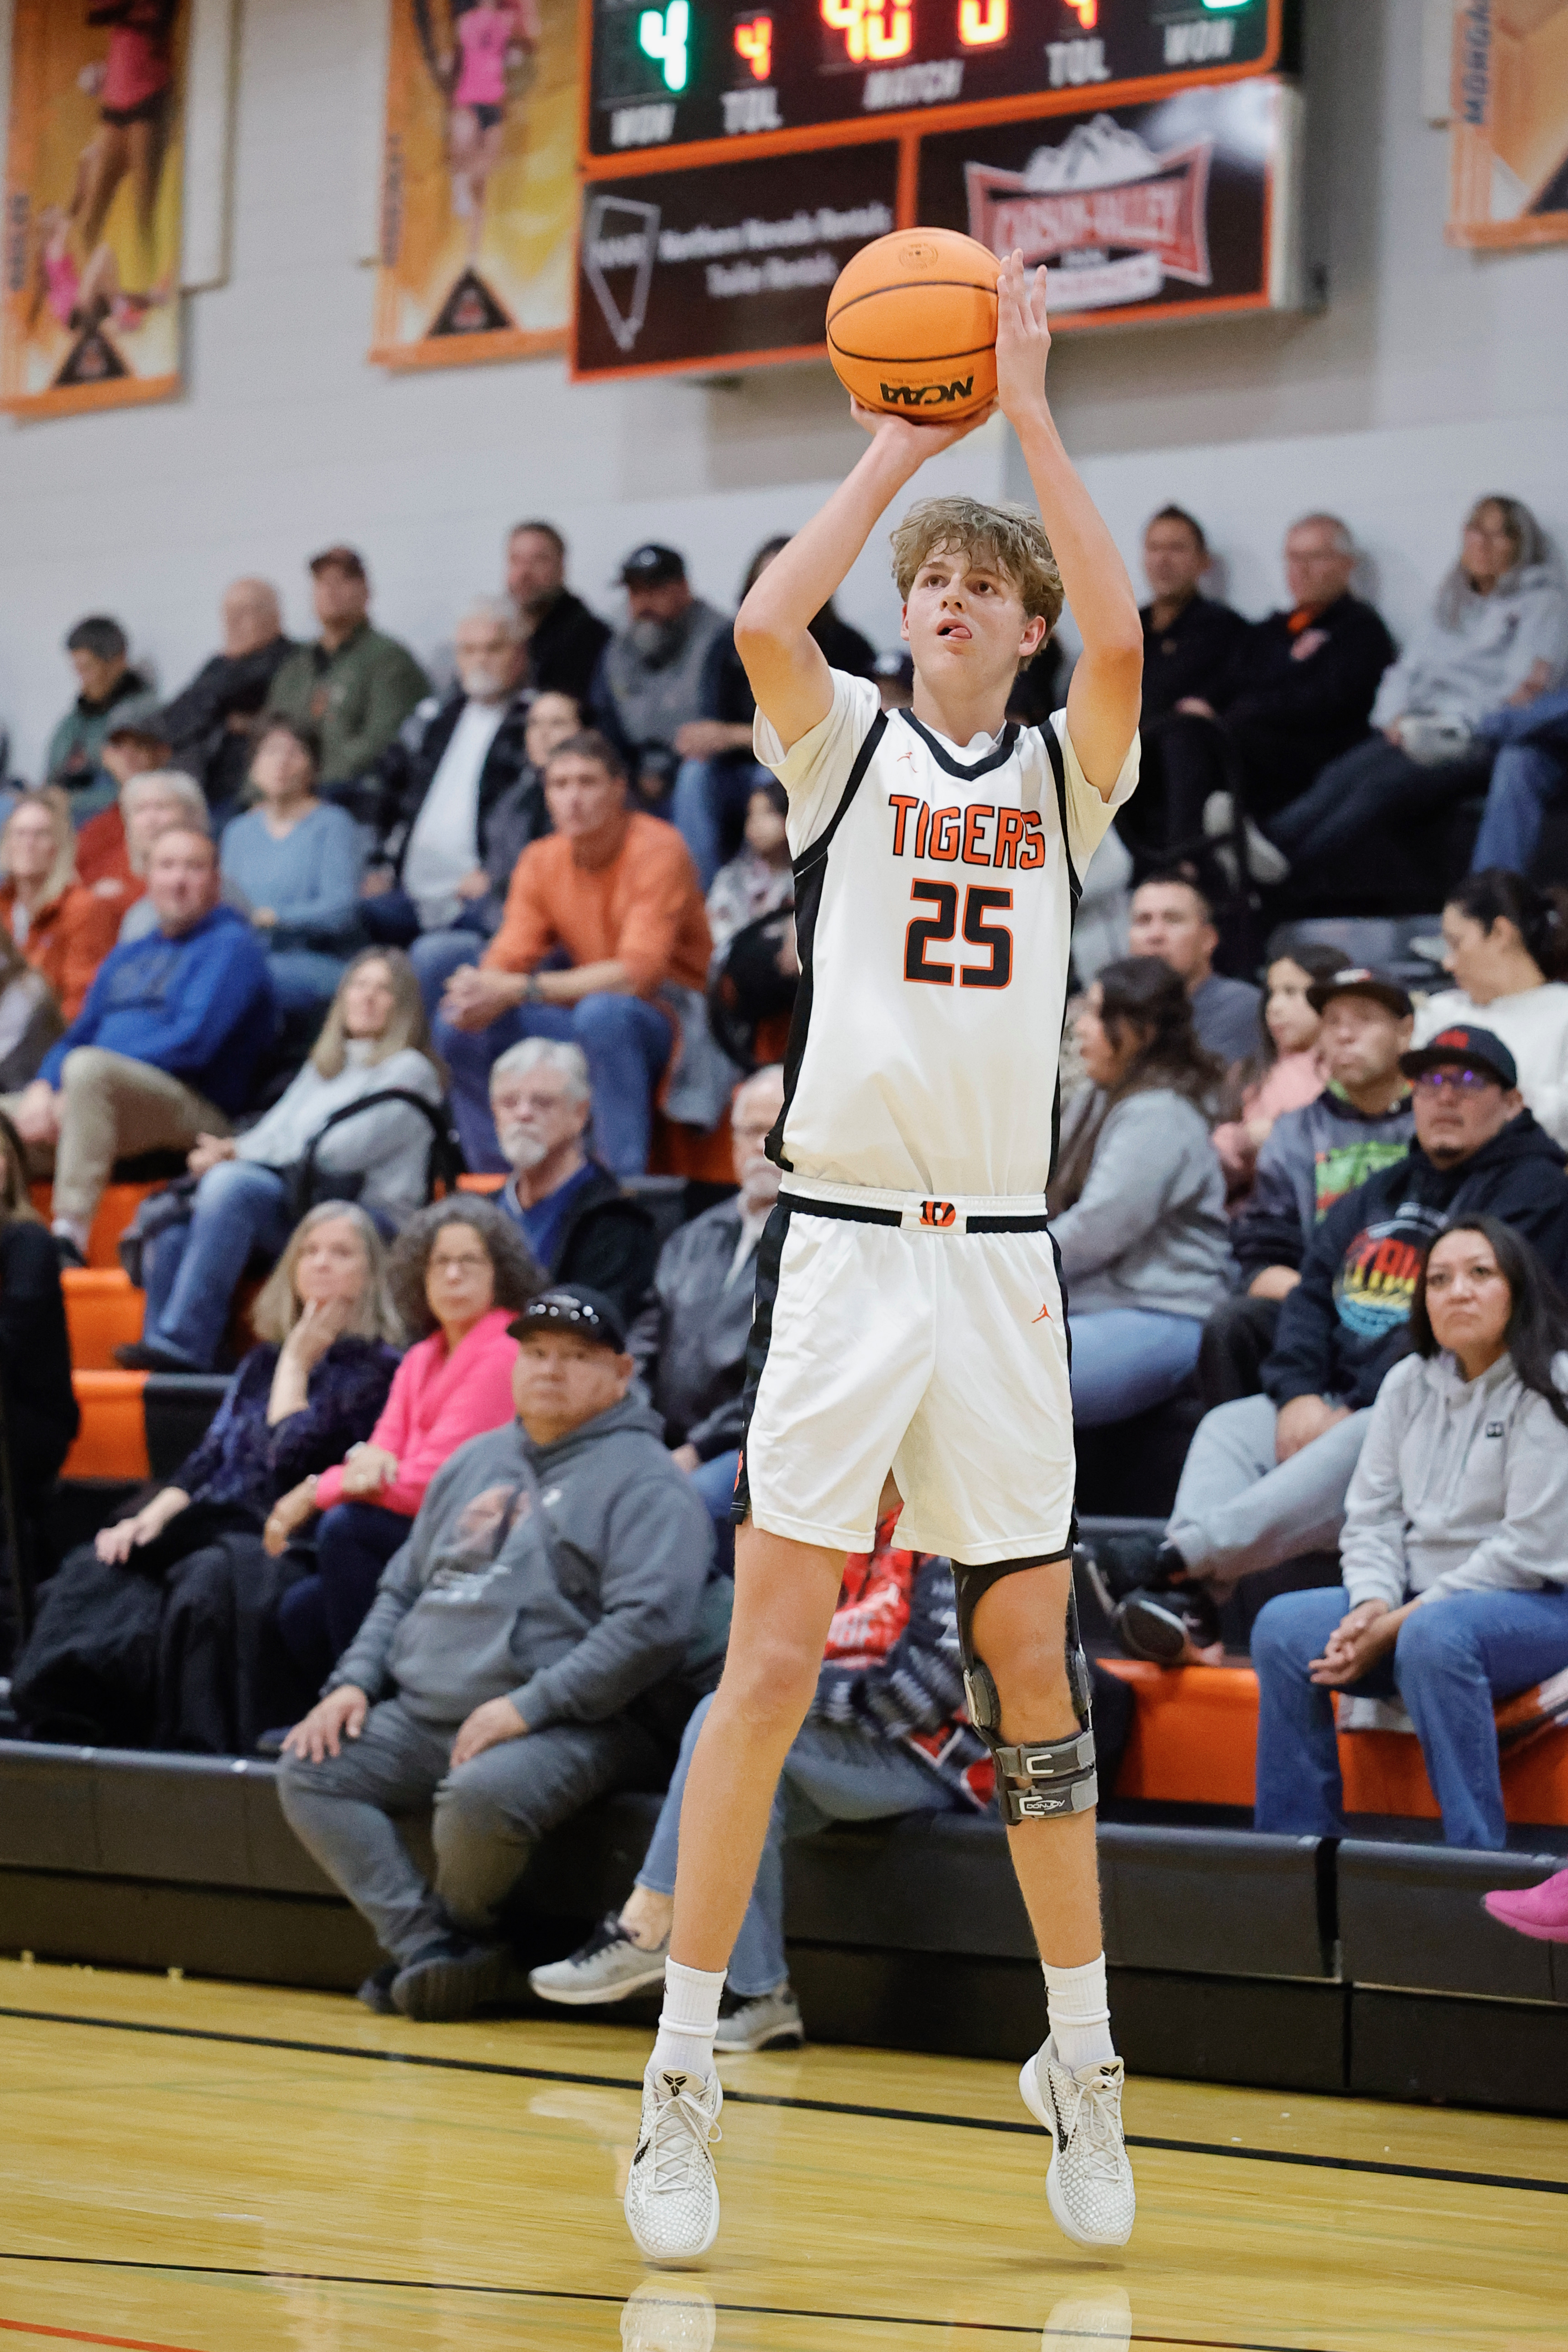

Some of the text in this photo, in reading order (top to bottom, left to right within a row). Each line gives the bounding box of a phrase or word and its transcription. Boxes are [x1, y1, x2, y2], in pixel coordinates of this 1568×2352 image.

[735, 16, 773, 81] 4
[880, 375, 974, 405] NCAA
[889, 794, 1046, 870] TIGERS
[904, 878, 1014, 990] 25
[1026, 1799, 1065, 1810] DONJOY
